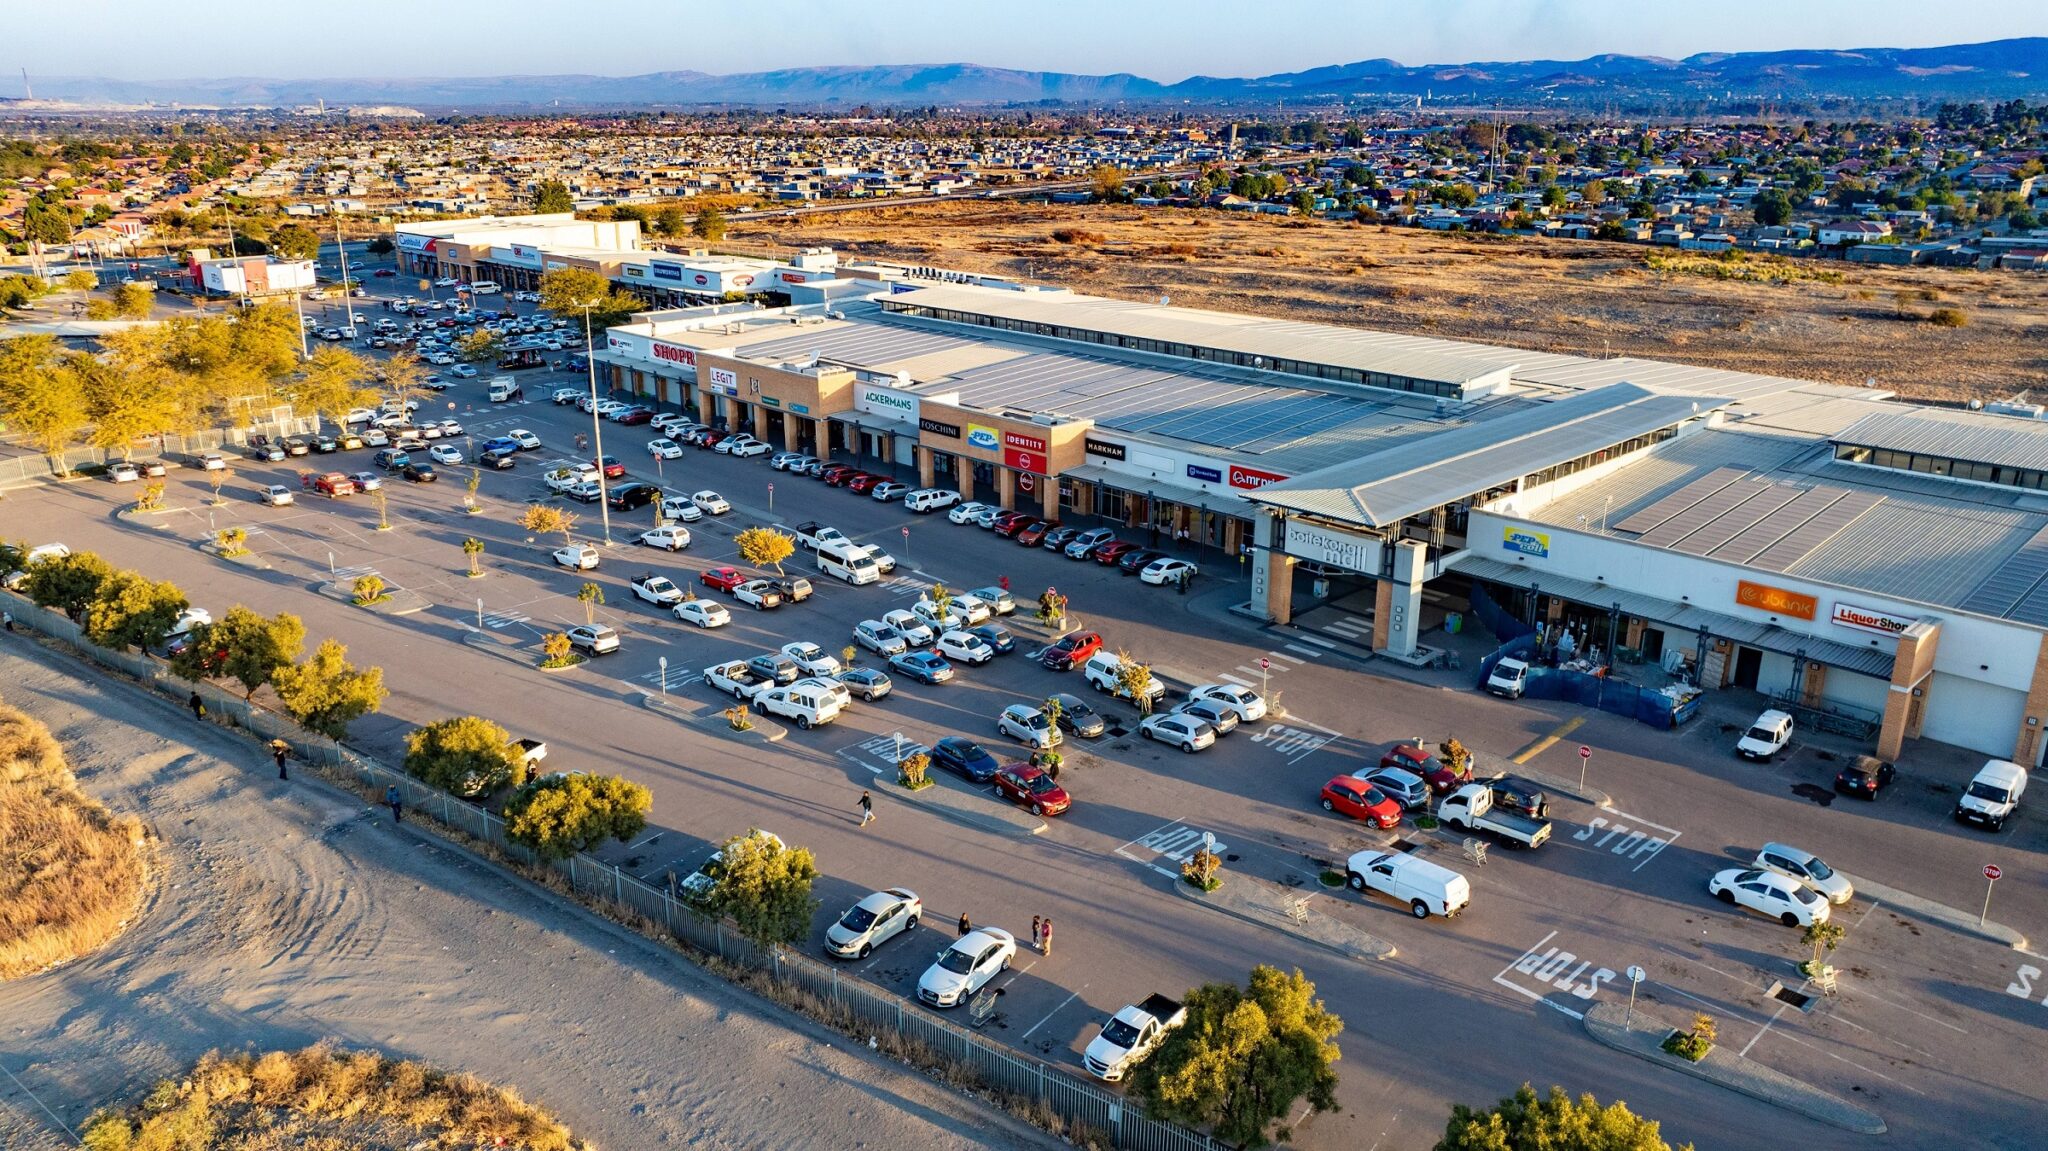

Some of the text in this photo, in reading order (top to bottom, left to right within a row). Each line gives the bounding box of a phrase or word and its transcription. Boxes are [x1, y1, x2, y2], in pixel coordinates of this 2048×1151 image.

[653, 343, 697, 366] SHOPR
[865, 391, 912, 411] ACKERMANS
[921, 421, 957, 437] FOSCHINI
[1006, 434, 1044, 450] IDENTITY
[1088, 443, 1123, 456] MARKHAM
[1246, 474, 1259, 486] mr
[1288, 528, 1356, 555] boitekong
[1323, 545, 1367, 572] mall
[1250, 724, 1327, 756] STOP
[1580, 748, 1591, 757] STOP
[1572, 817, 1668, 859] STOP
[1985, 867, 2001, 877] STOP
[1515, 946, 1617, 1000] STOP
